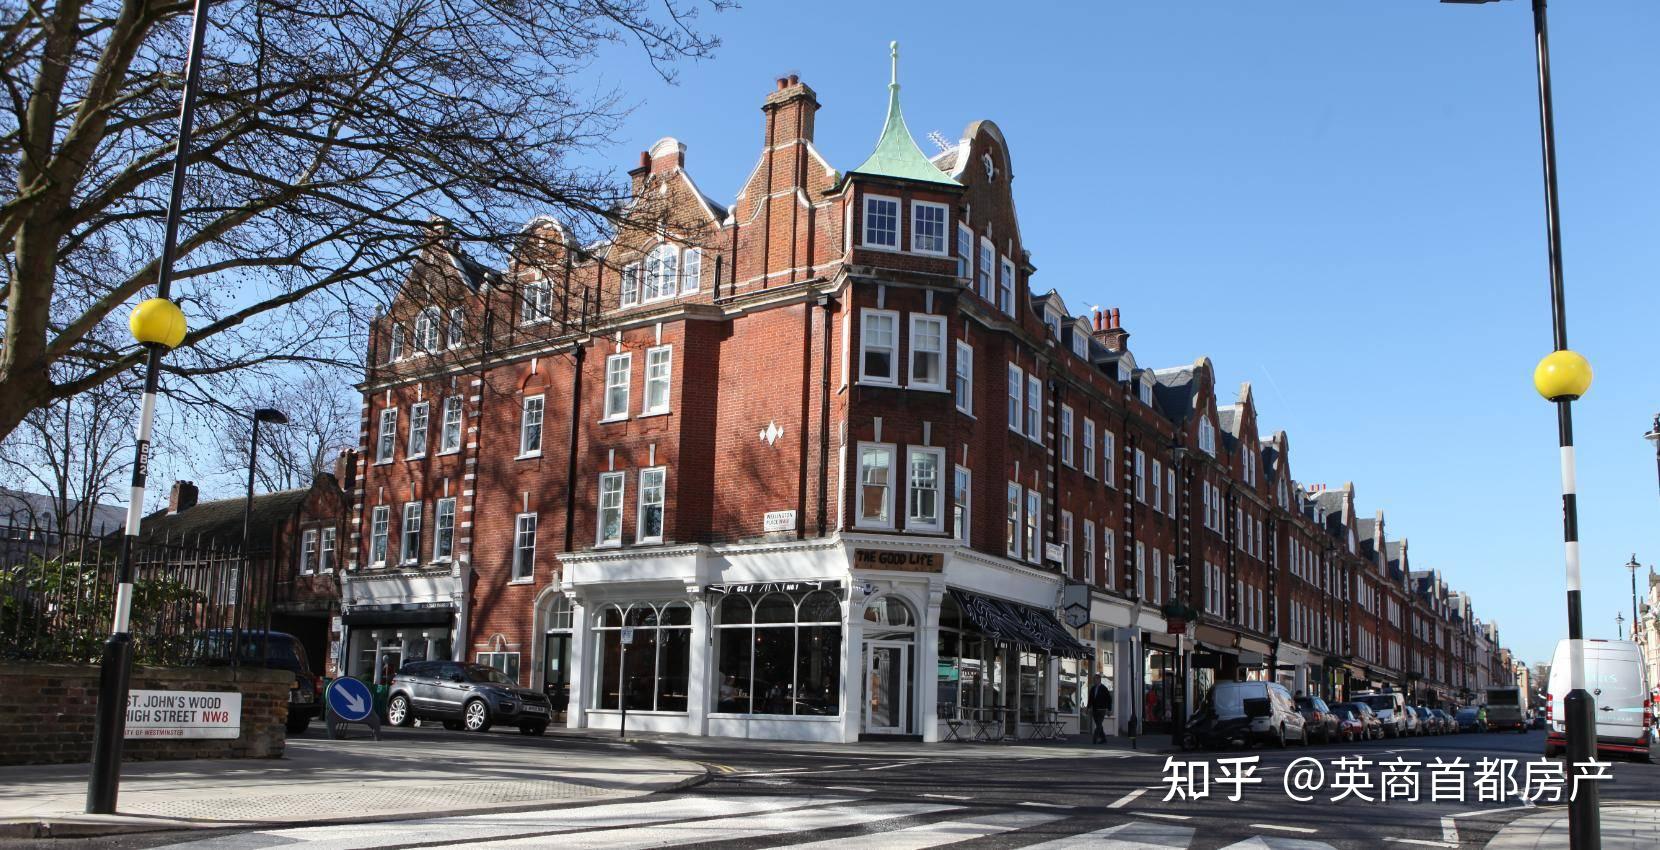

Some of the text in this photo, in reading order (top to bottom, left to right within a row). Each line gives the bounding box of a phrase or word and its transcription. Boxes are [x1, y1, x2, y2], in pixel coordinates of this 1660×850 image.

[856, 550, 933, 566] THE GOOD LIFE
[143, 695, 185, 709] JOHN'S
[189, 697, 221, 709] WOOD
[154, 710, 197, 722] STREET
[202, 711, 229, 723] NW8
